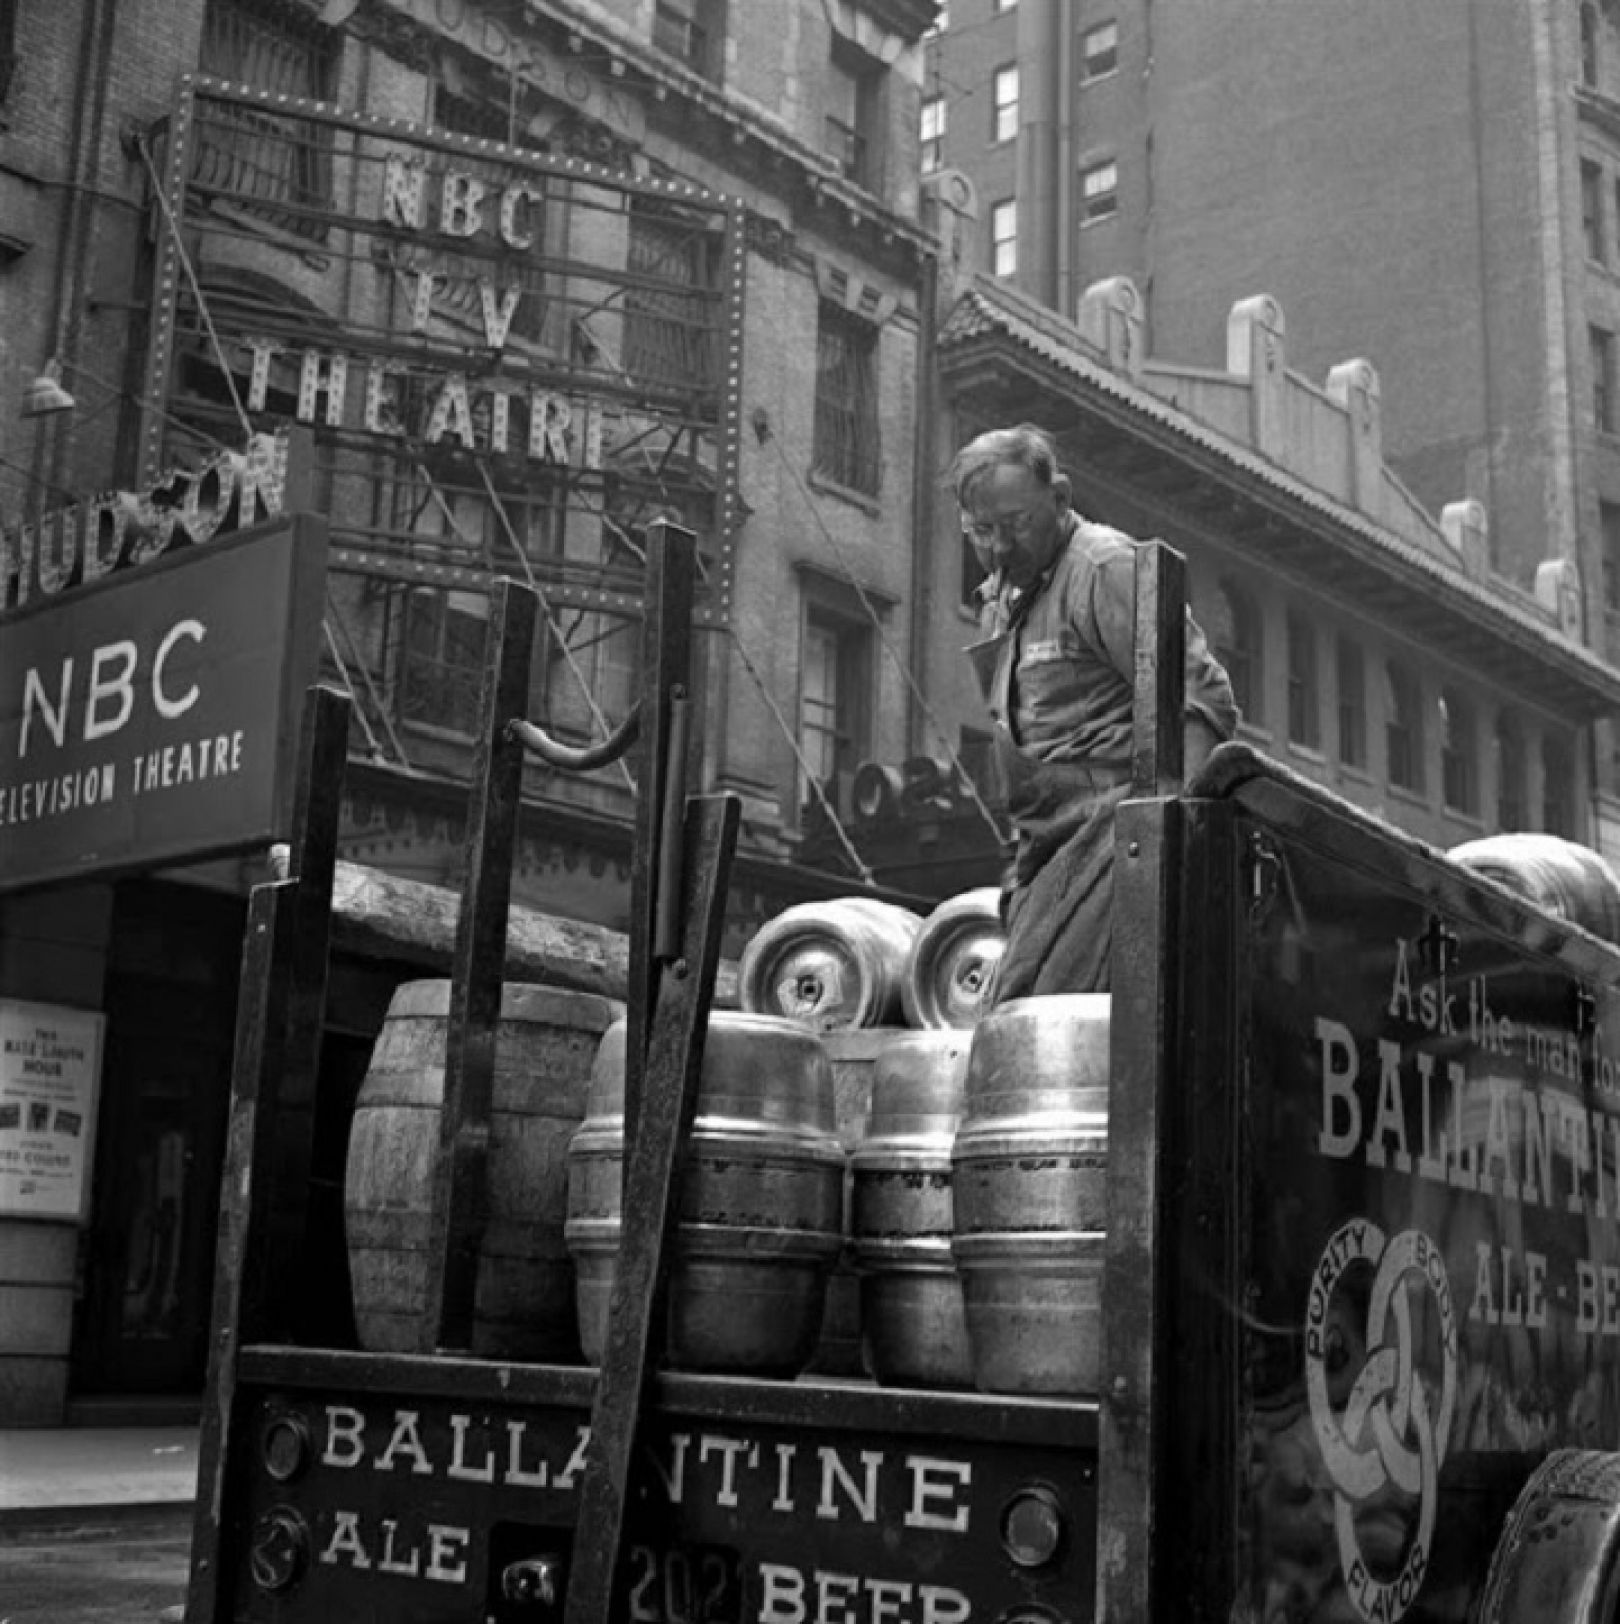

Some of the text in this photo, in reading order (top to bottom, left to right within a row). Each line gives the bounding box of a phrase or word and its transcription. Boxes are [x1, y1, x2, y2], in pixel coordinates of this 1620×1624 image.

[384, 153, 544, 249] NBC
[411, 265, 523, 348] TV
[241, 336, 610, 470] THEATRE
[19, 619, 206, 757] NBC
[134, 730, 244, 794] THEATRE
[1388, 937, 1458, 1037] Ask
[1469, 974, 1512, 1057] the
[1526, 1026, 1583, 1084] man
[1308, 1223, 1367, 1360] PURITY
[1469, 1241, 1547, 1327] ALE
[322, 1512, 470, 1583] ALE
[1349, 1543, 1426, 1623] FLAVOR
